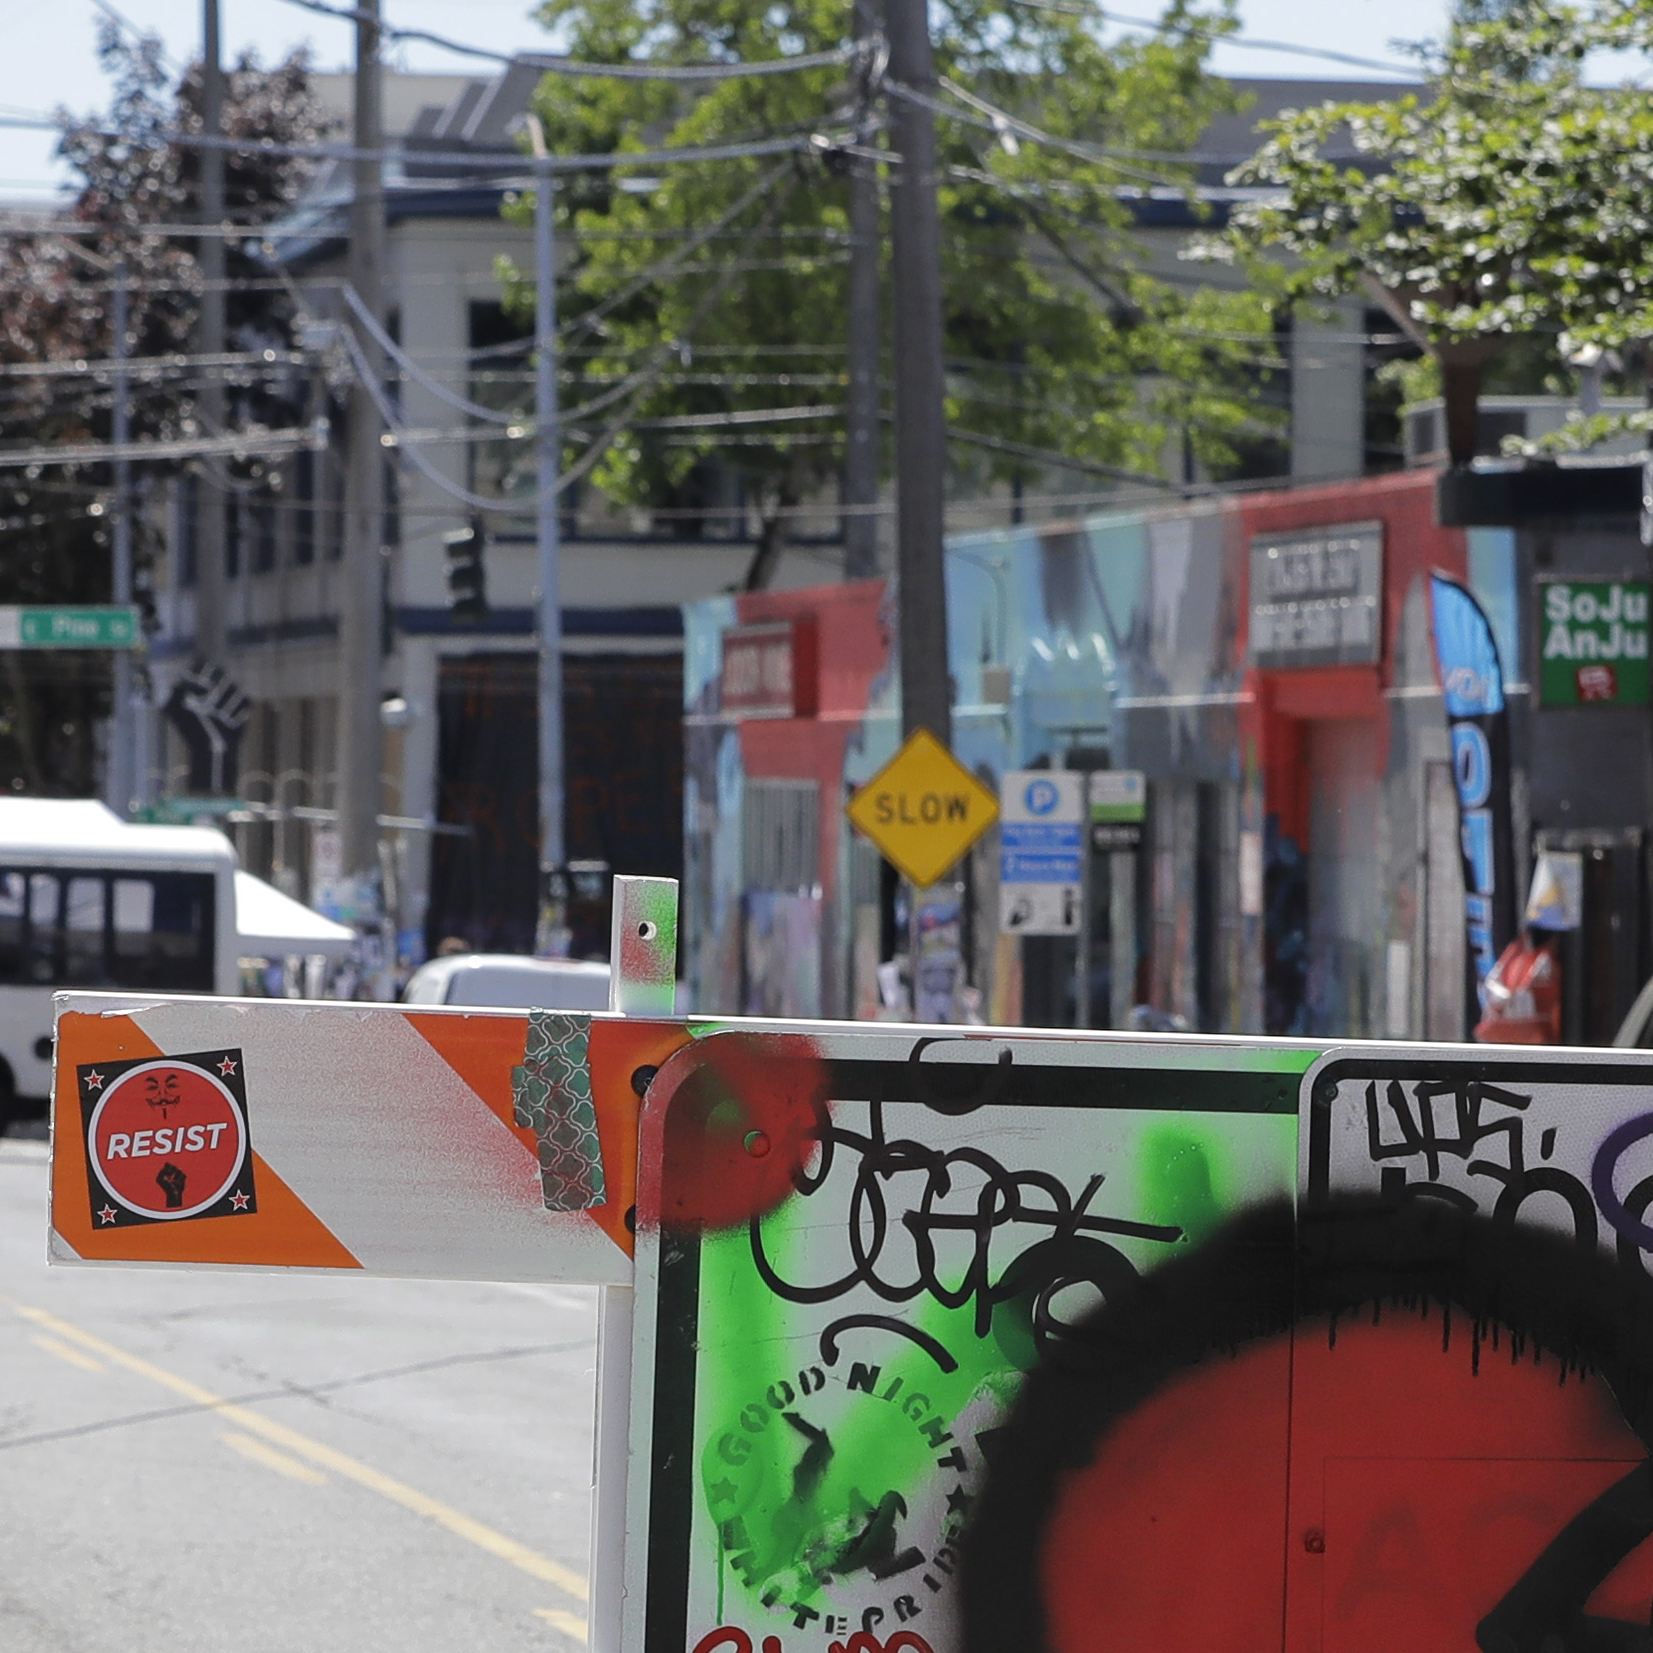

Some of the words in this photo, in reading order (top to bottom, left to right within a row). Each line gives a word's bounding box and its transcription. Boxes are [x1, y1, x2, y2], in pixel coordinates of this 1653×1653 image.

[1545, 584, 1649, 623] SoJu
[1543, 623, 1649, 660] AnJu
[875, 791, 969, 825] SLOW
[106, 1121, 228, 1161] RESIST
[718, 1366, 826, 1466] GOOD
[847, 1362, 967, 1473] NIGHT
